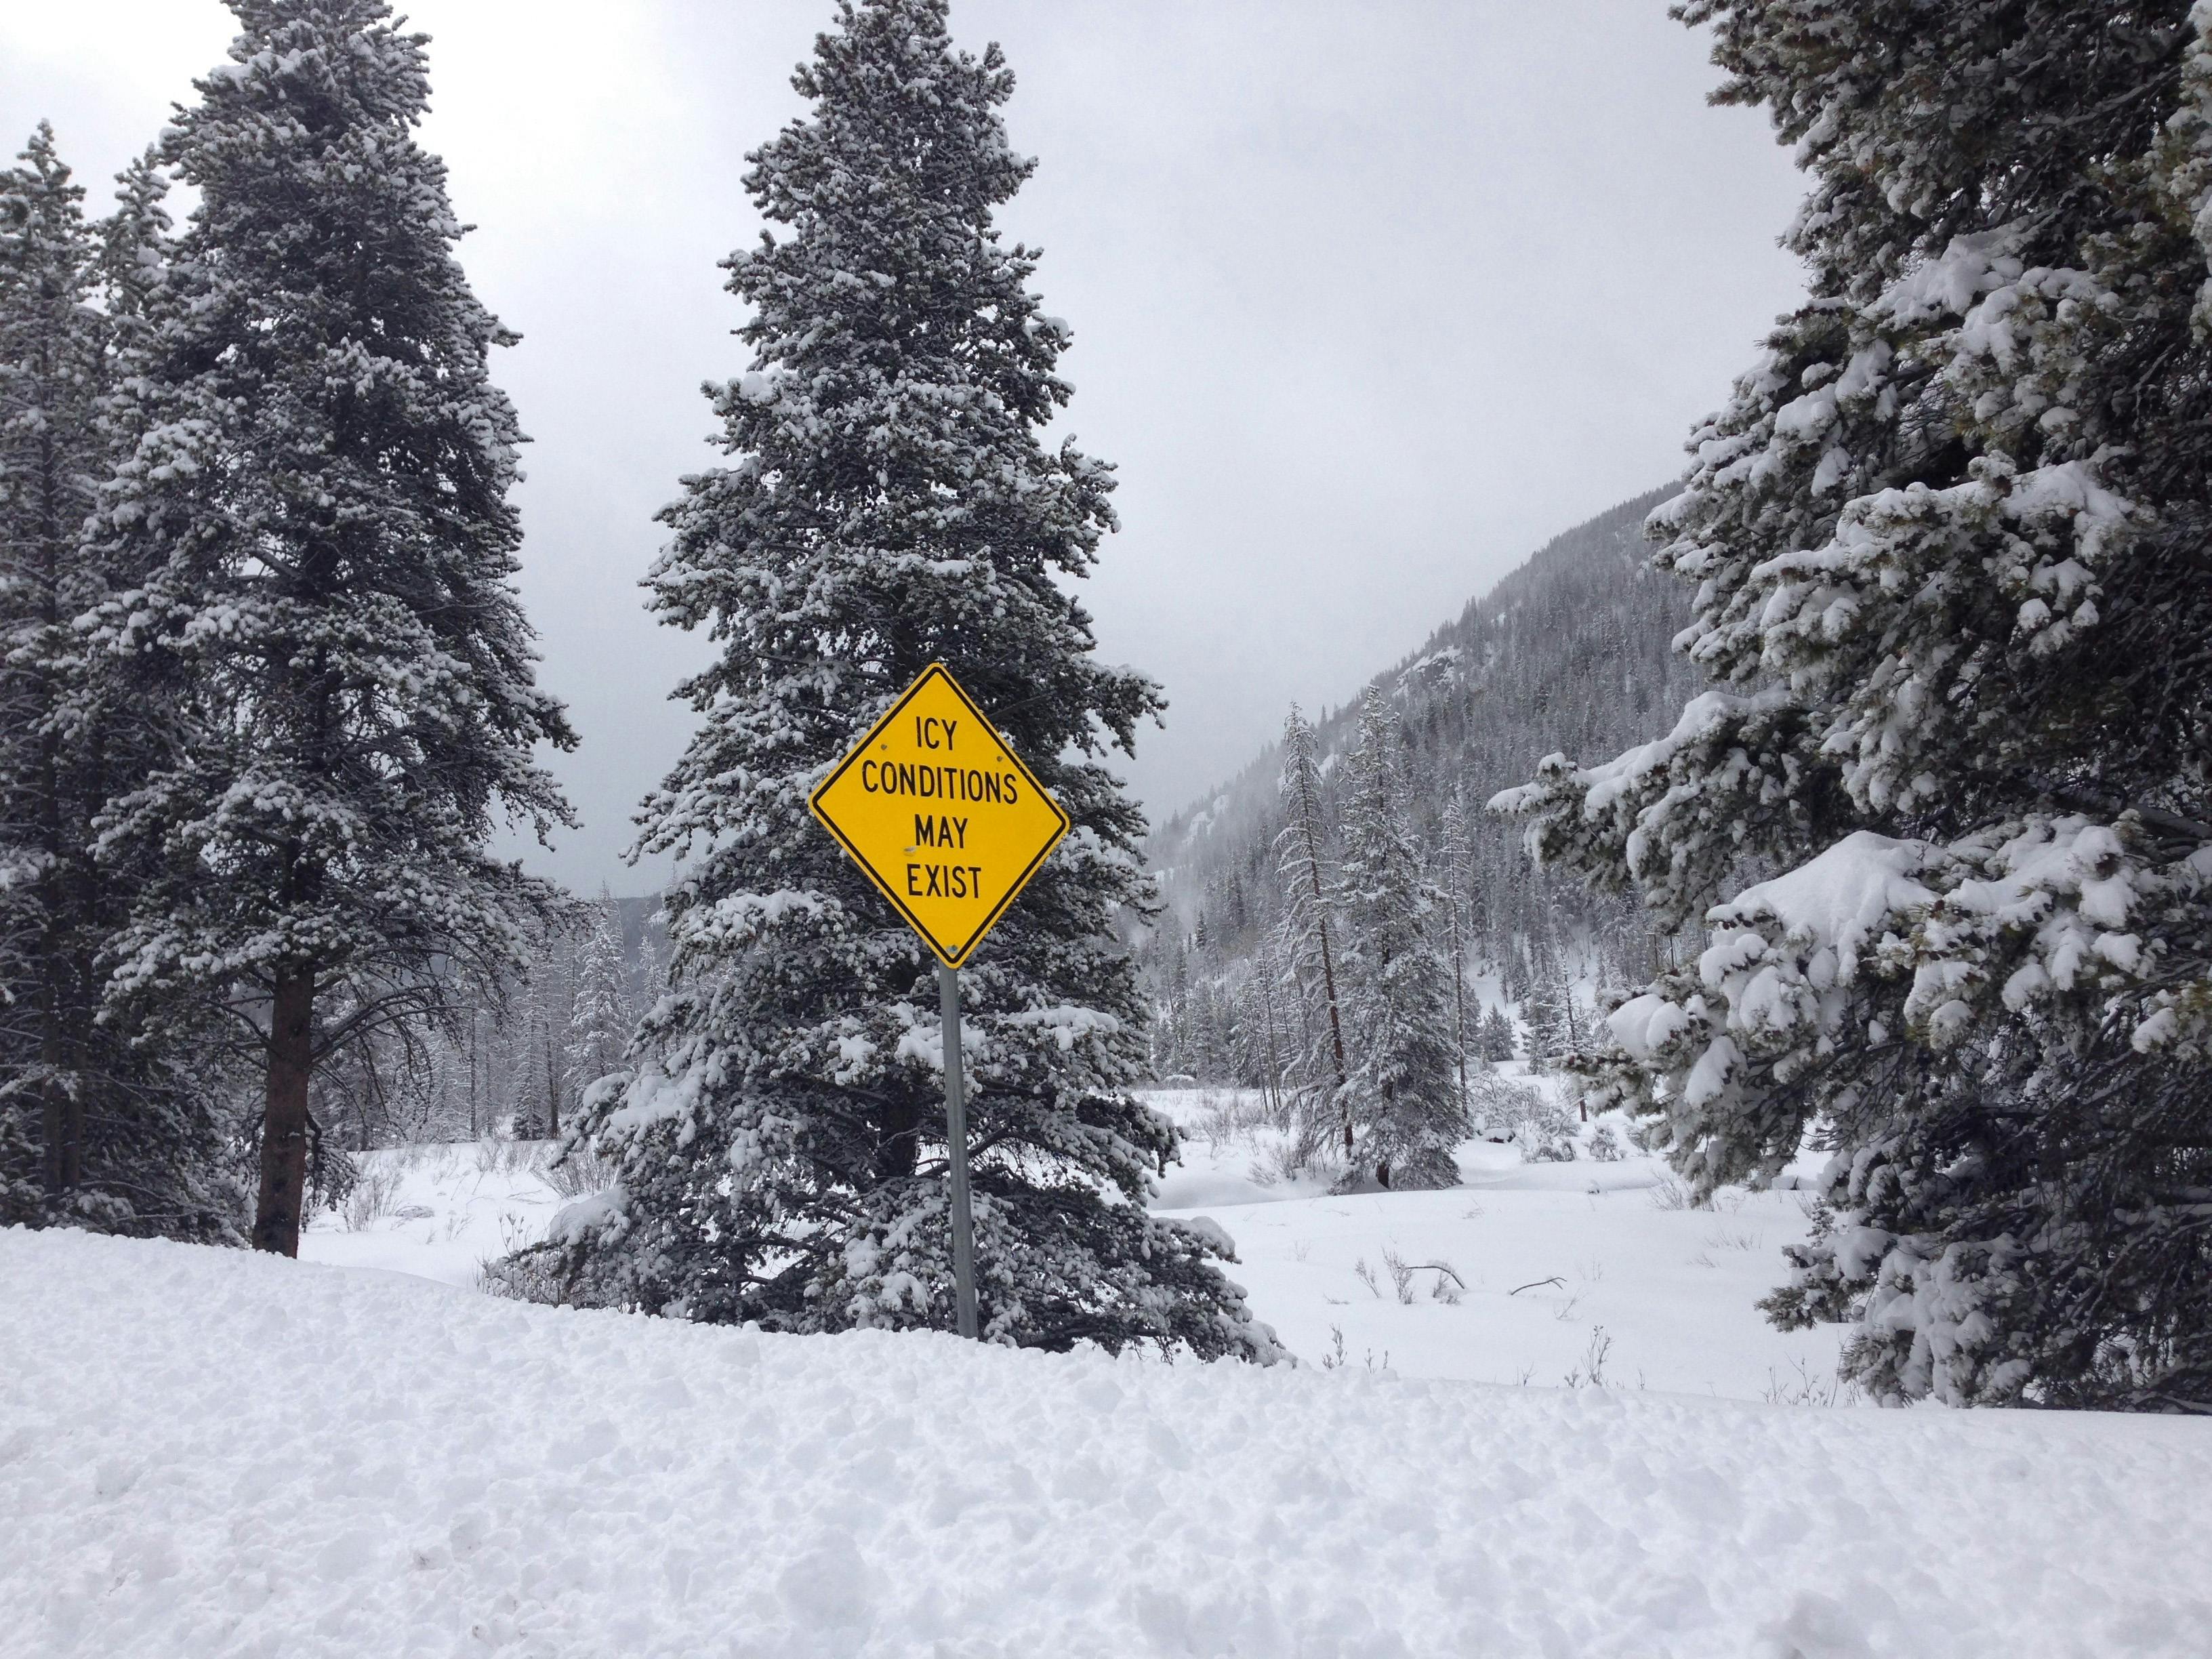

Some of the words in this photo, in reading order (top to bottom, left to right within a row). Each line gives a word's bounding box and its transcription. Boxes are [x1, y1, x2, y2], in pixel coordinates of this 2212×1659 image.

[916, 716, 957, 751] ICY
[862, 760, 1018, 805] CONDITIONS
[915, 814, 968, 848] MAY
[907, 863, 981, 899] EXIST
